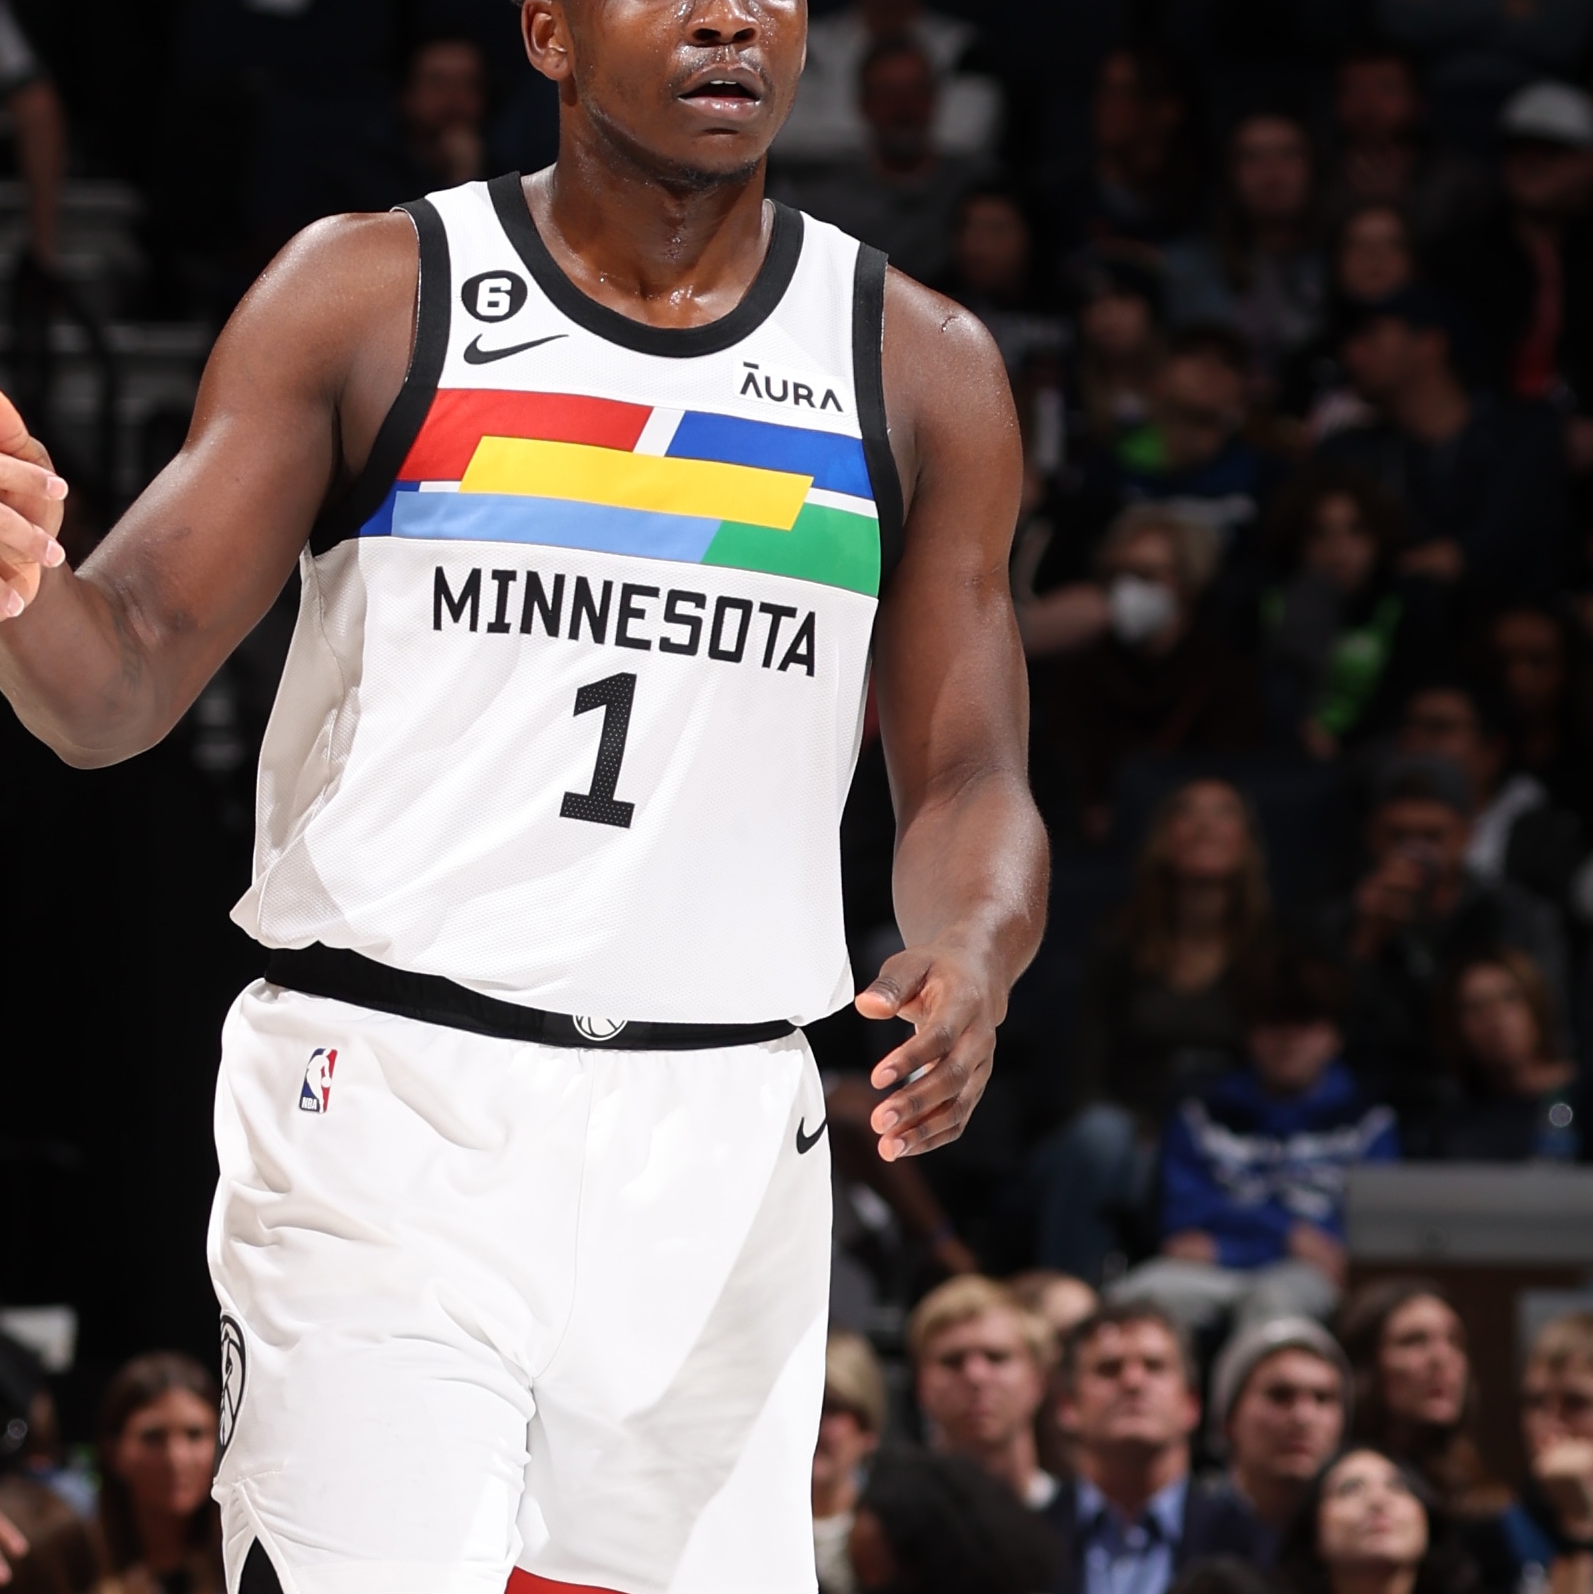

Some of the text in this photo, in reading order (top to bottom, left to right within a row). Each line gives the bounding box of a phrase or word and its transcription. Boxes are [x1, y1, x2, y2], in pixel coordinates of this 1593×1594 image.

[475, 277, 512, 317] 6
[433, 565, 816, 678] MINNESOTA
[559, 671, 638, 829] 1
[301, 1095, 318, 1111] NBA
